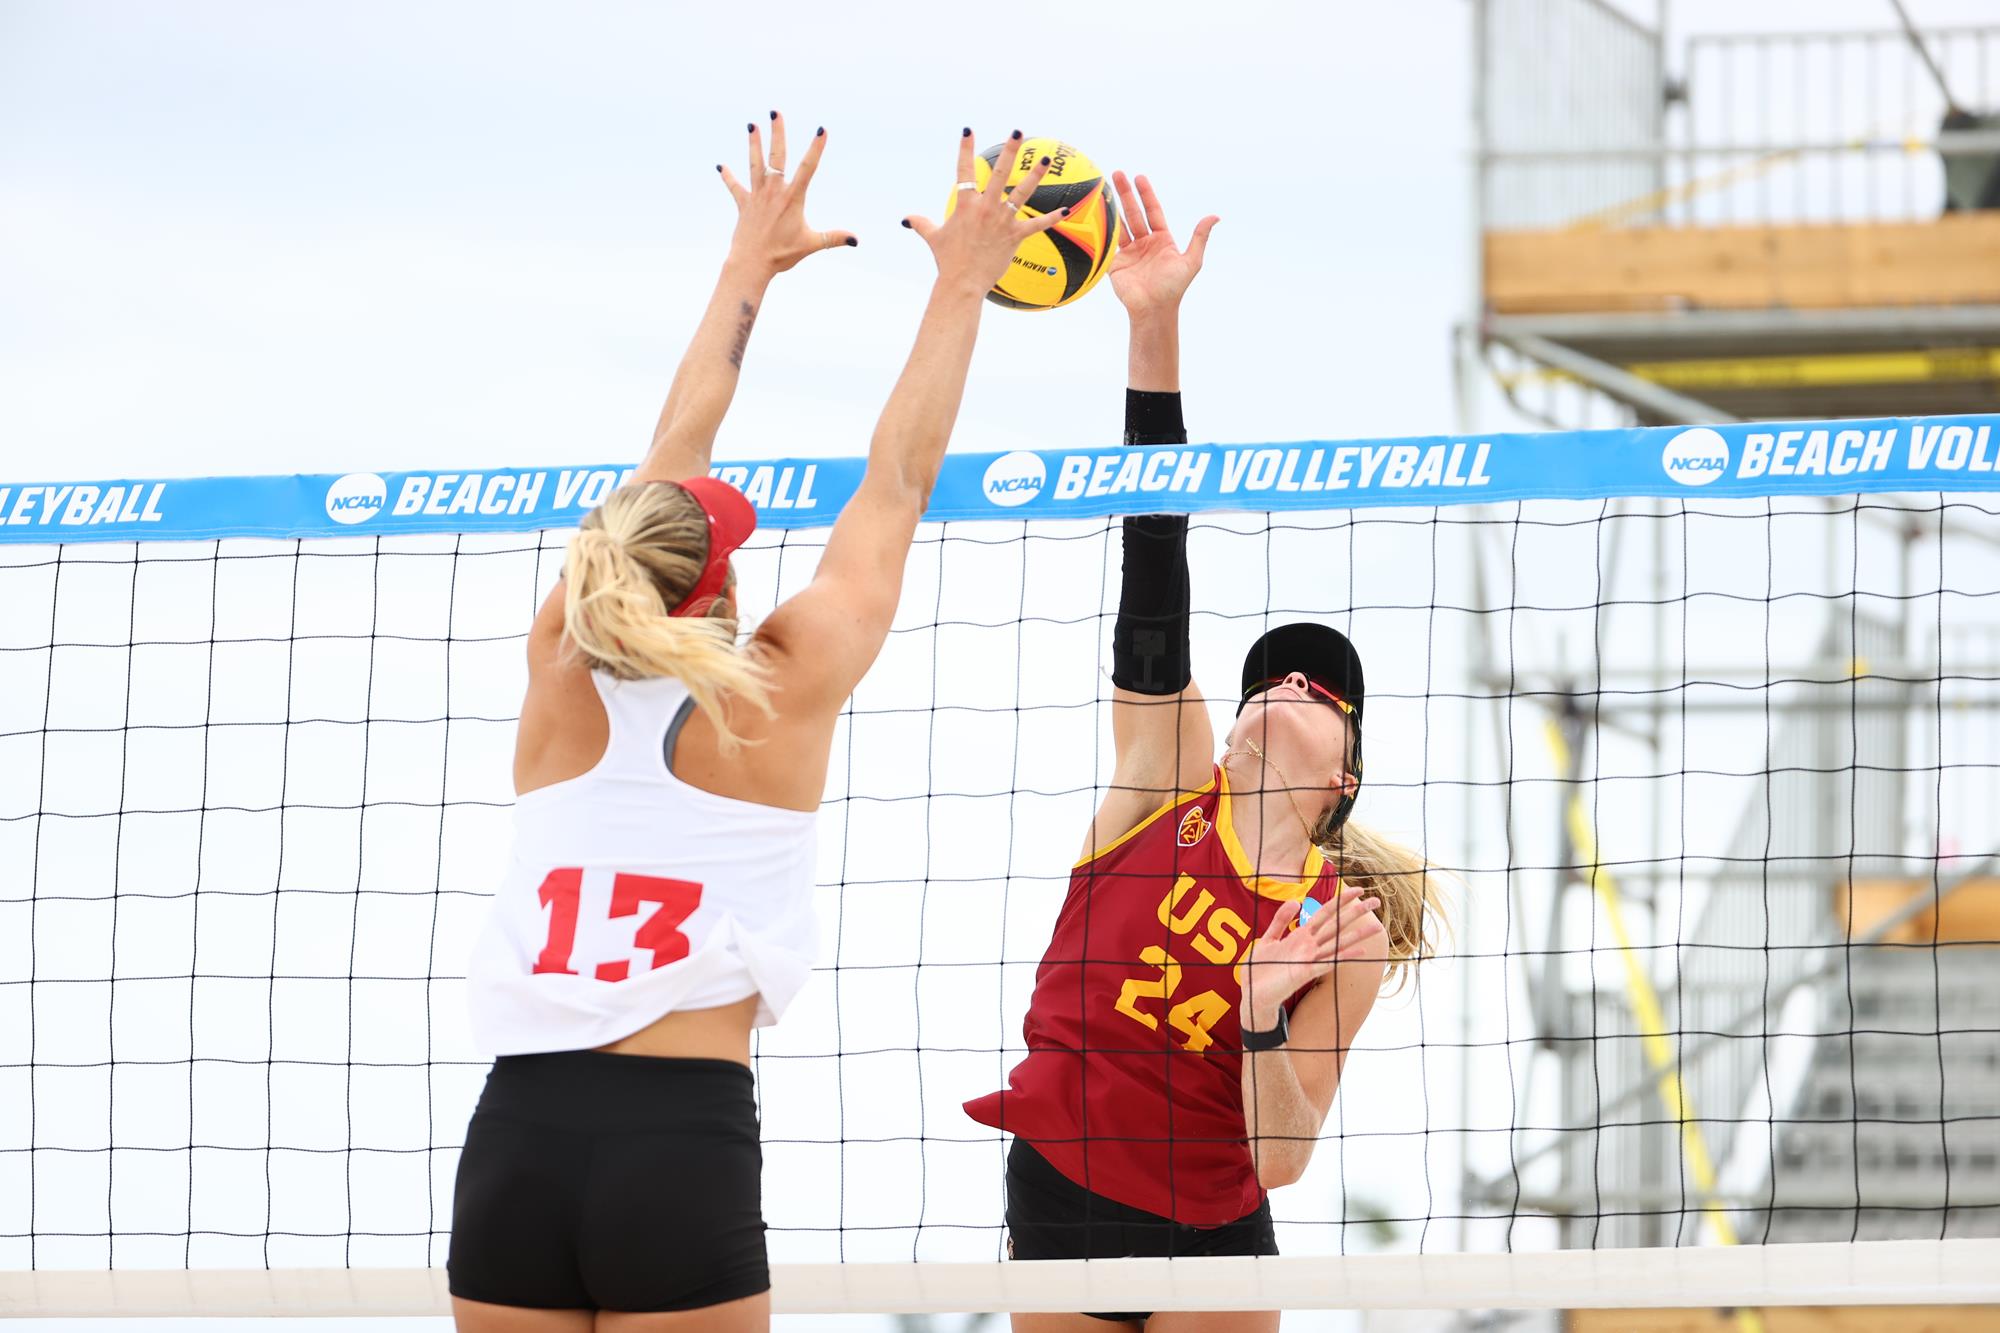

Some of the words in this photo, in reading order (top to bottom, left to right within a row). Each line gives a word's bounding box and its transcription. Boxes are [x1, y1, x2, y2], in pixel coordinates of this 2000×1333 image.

[989, 476, 1042, 494] NCAA
[1053, 450, 1212, 500] BEACH
[1219, 443, 1492, 494] VOLLEYBALL
[1669, 456, 1725, 471] NCAA
[1736, 428, 1898, 480] BEACH
[330, 495, 382, 512] NCAA
[391, 471, 547, 516] BEACH
[531, 867, 704, 983] 13
[1113, 945, 1232, 1057] 24
